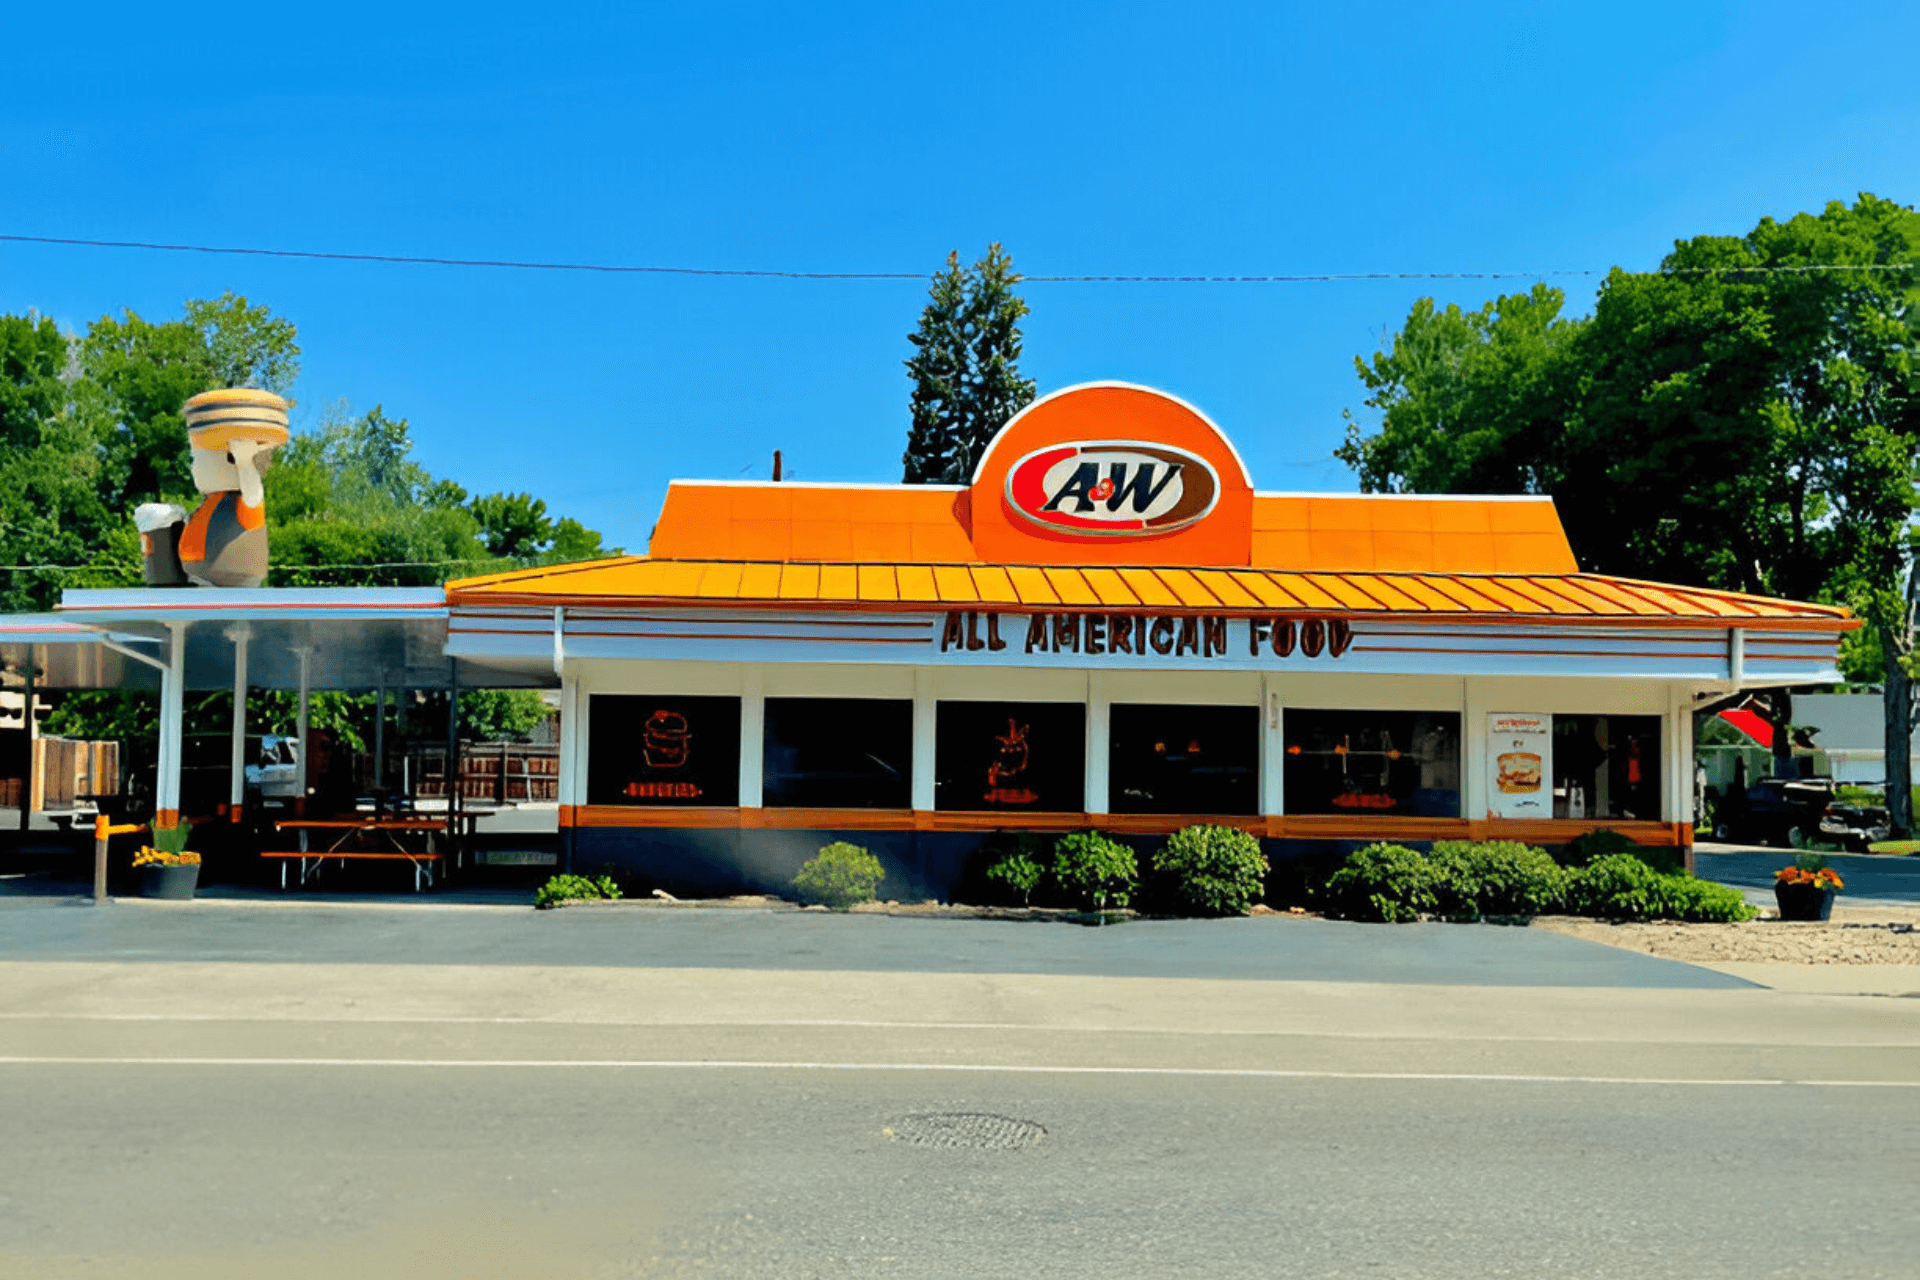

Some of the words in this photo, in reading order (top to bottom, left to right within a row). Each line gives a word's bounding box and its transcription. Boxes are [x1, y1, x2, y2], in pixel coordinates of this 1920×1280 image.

[1042, 462, 1183, 513] A&W
[941, 611, 1006, 652] ALL
[1024, 614, 1227, 657] AMERICAN
[1250, 617, 1353, 658] FOOD
